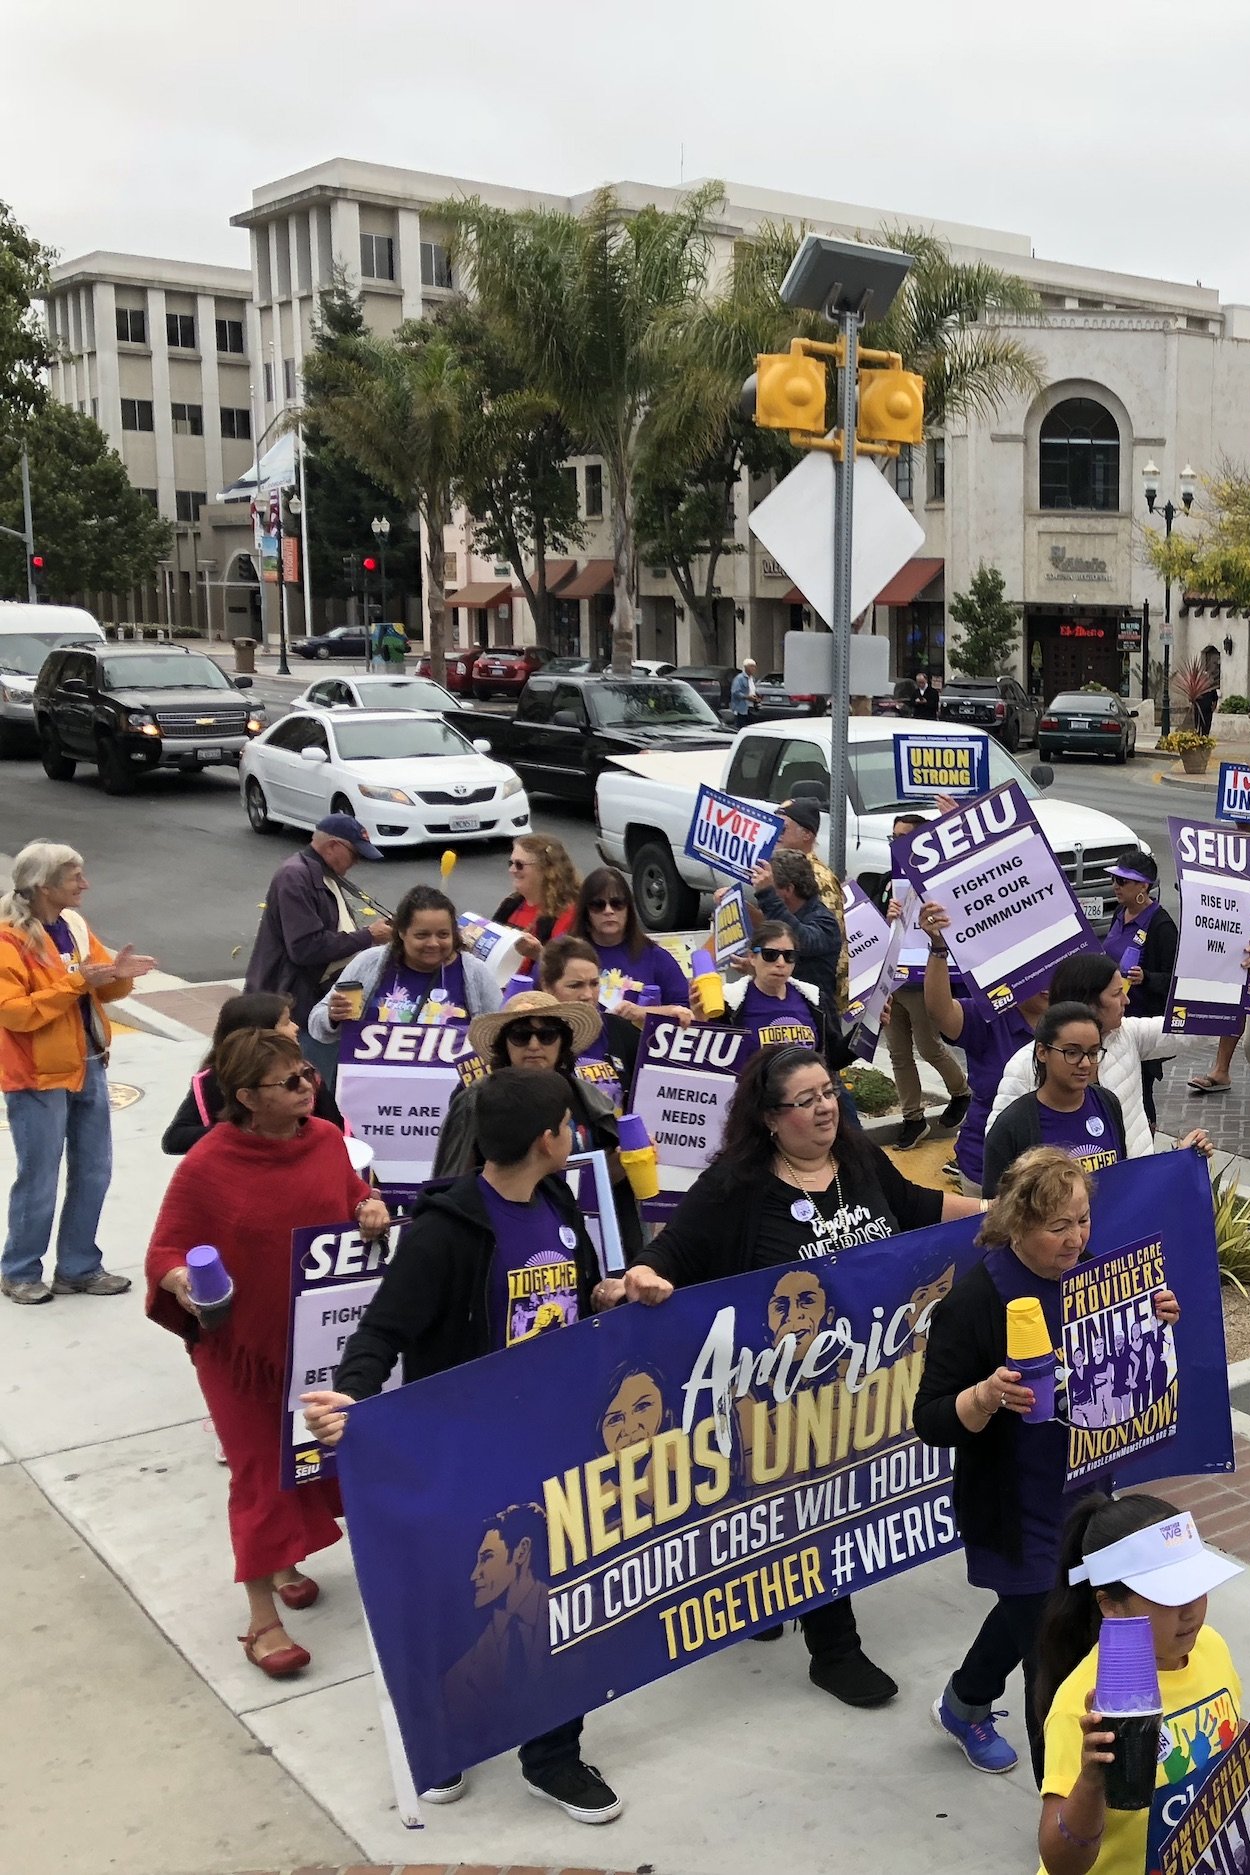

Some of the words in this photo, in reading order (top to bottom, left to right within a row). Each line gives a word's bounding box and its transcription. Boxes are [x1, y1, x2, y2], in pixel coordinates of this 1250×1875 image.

[910, 748, 969, 768] UNION
[913, 768, 970, 786] STRONG
[1233, 769, 1238, 789] I
[706, 797, 714, 821] I
[698, 819, 756, 868] UNION
[911, 789, 1017, 874] SEIU
[1180, 826, 1247, 872] SEIU
[952, 856, 1024, 900] FIGHTING
[964, 895, 996, 917] FOR
[997, 875, 1031, 898] OUR
[1201, 894, 1222, 909] RISE
[1224, 899, 1239, 912] UP.
[956, 883, 1055, 944] COMMMUNITY
[1195, 915, 1243, 935] ORGANIZE.
[848, 935, 879, 959] UNION
[1207, 939, 1226, 954] WIN.
[993, 993, 1015, 1010] SEIU
[760, 1026, 814, 1043] TOGETHER
[1171, 1019, 1184, 1028] SEIU
[353, 1024, 474, 1063] SEIU
[648, 1023, 742, 1067] SEIU
[657, 1086, 717, 1105] AMERICA
[377, 1105, 402, 1117] WE
[407, 1106, 441, 1117] ARE
[662, 1109, 706, 1126] NEEDS
[361, 1124, 394, 1136] THE
[400, 1125, 440, 1137] UNIO
[655, 1131, 706, 1148] UNIONS
[798, 1239, 835, 1260] WE
[839, 1217, 892, 1249] RISE
[509, 1263, 576, 1296] TOGETHE
[1062, 1267, 1100, 1296] FAMILY
[1104, 1254, 1134, 1277] CHILD
[1137, 1241, 1162, 1265] CARE
[1063, 1257, 1165, 1324] PROVIDERS
[1065, 1288, 1167, 1366] UNITED
[1069, 1422, 1131, 1470] UNION
[1130, 1378, 1179, 1442] NOW!
[295, 1465, 320, 1479] SEIU
[543, 1416, 731, 1577] NEEDS
[1159, 1522, 1180, 1532] TOGETHER
[1162, 1528, 1181, 1540] we
[548, 1581, 594, 1647] NO
[603, 1530, 700, 1619] COURT
[709, 1501, 785, 1568] CASE
[794, 1479, 862, 1531] WILL
[869, 1445, 940, 1504] HOLD
[659, 1546, 826, 1660] TOGETHER
[831, 1494, 962, 1587] #WERIS
[1163, 1792, 1210, 1868] FAMILY
[1212, 1739, 1247, 1797] CHILD
